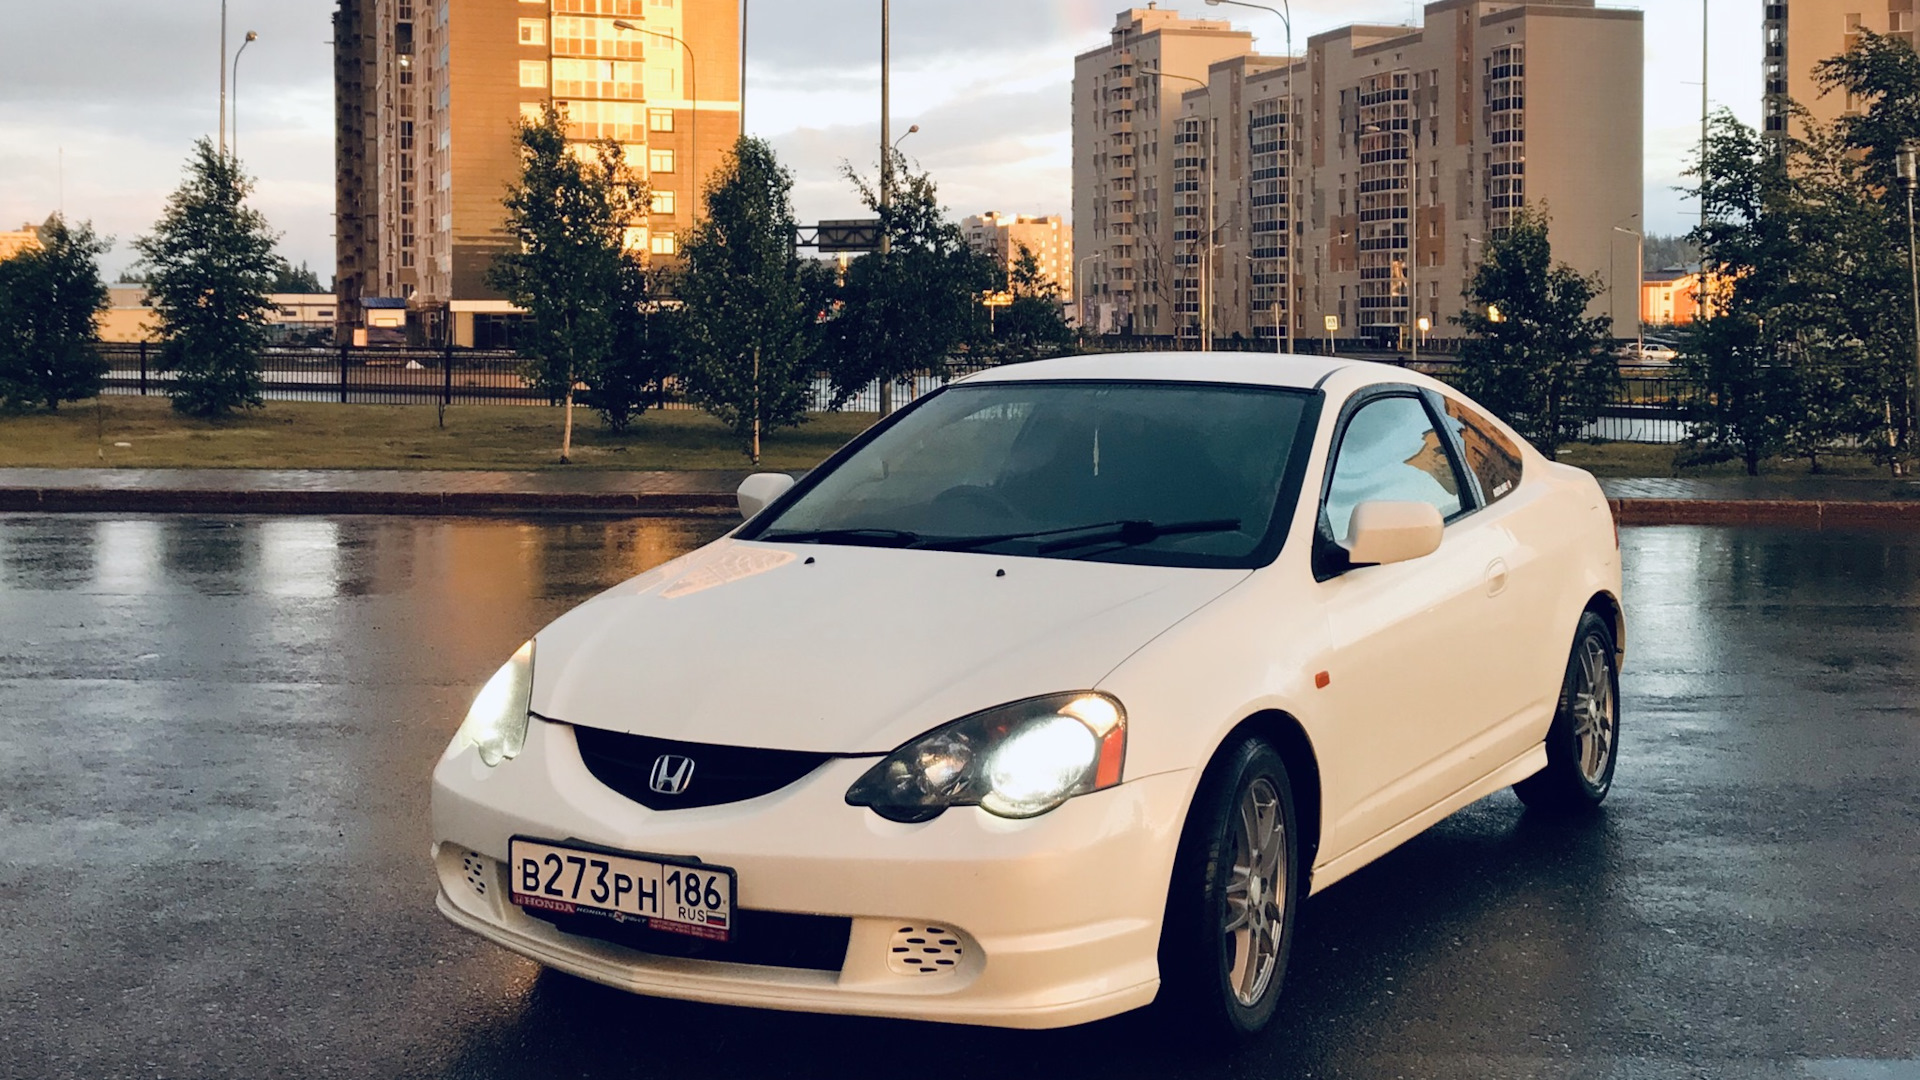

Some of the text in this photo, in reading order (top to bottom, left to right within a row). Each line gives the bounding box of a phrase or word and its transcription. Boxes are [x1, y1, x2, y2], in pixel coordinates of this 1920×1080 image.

[666, 870, 722, 910] 186
[524, 896, 576, 913] HONDA
[678, 906, 705, 922] RUS
